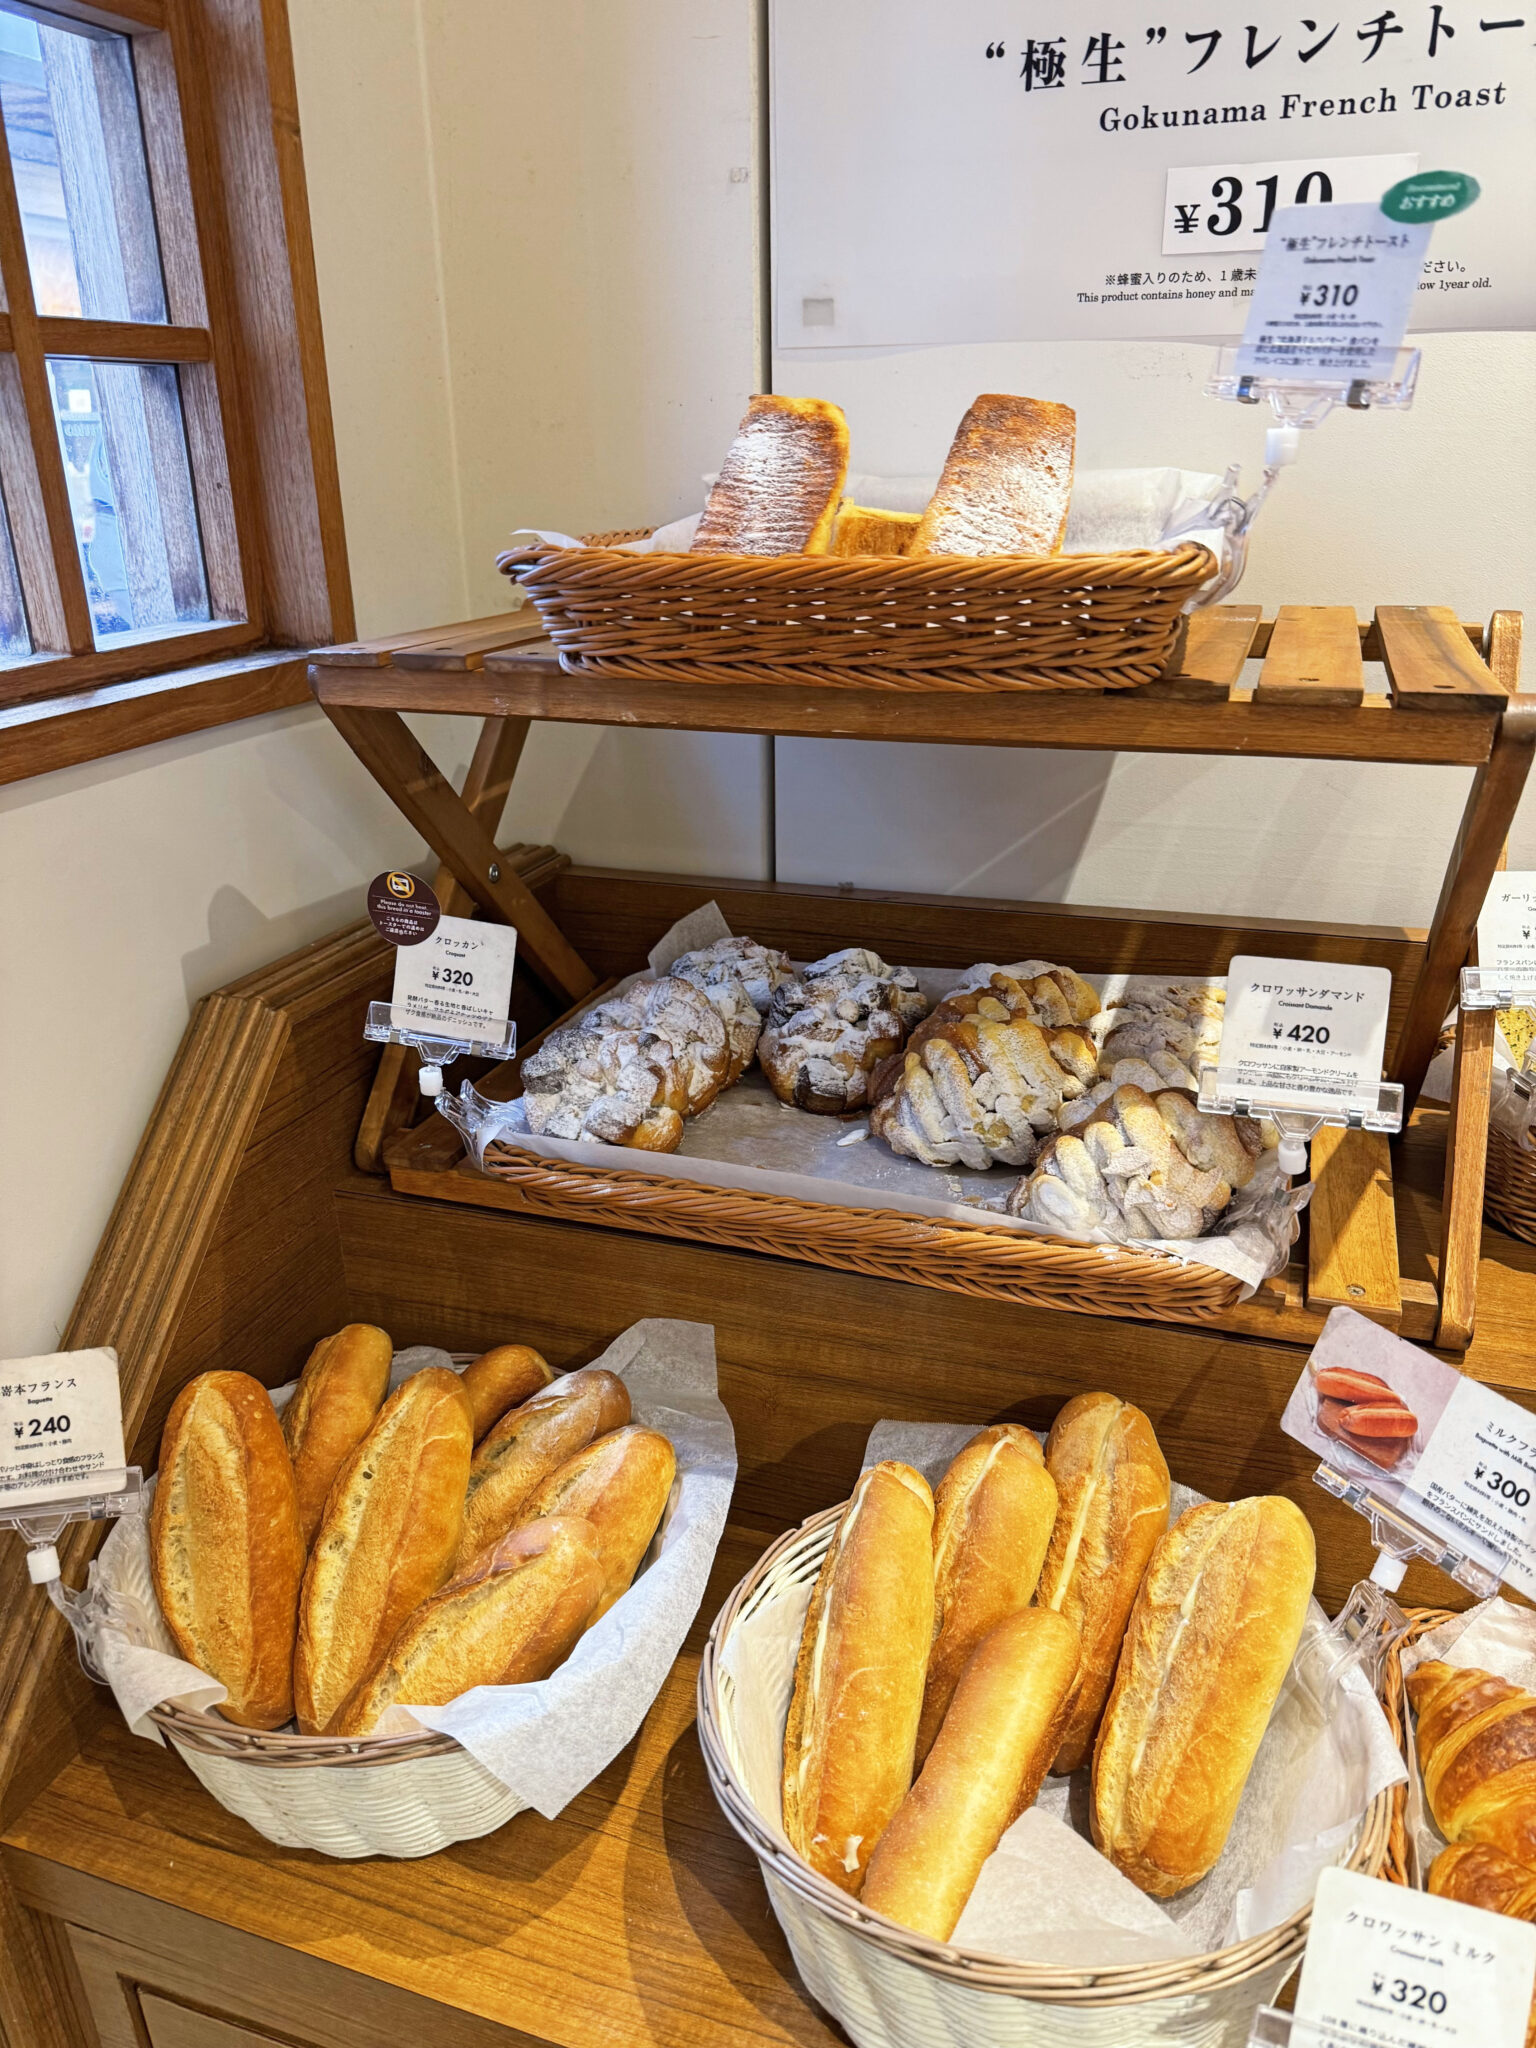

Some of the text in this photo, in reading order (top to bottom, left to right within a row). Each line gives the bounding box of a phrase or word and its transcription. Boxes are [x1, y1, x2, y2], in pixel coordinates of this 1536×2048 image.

[986, 5, 1536, 92] “極生”フレンチトー
[1099, 81, 1507, 131] Gokunama French Toast
[1077, 293, 1099, 303] This
[1101, 291, 1138, 304] product
[1141, 288, 1183, 301] contains
[1186, 288, 1215, 300] honey
[1218, 287, 1238, 298] and
[1472, 277, 1492, 289] old.
[1300, 284, 1359, 307] ¥310
[435, 936, 479, 950] クロッカン
[432, 968, 474, 987] ¥320
[1251, 982, 1365, 1003] クロワッサンダマンド
[1272, 1023, 1330, 1045] ¥420
[14, 1415, 71, 1438] ¥240
[1474, 1467, 1530, 1507] ¥300
[1345, 1911, 1497, 1964] クロワッサン ミルク
[1372, 1978, 1447, 2014] ¥320
